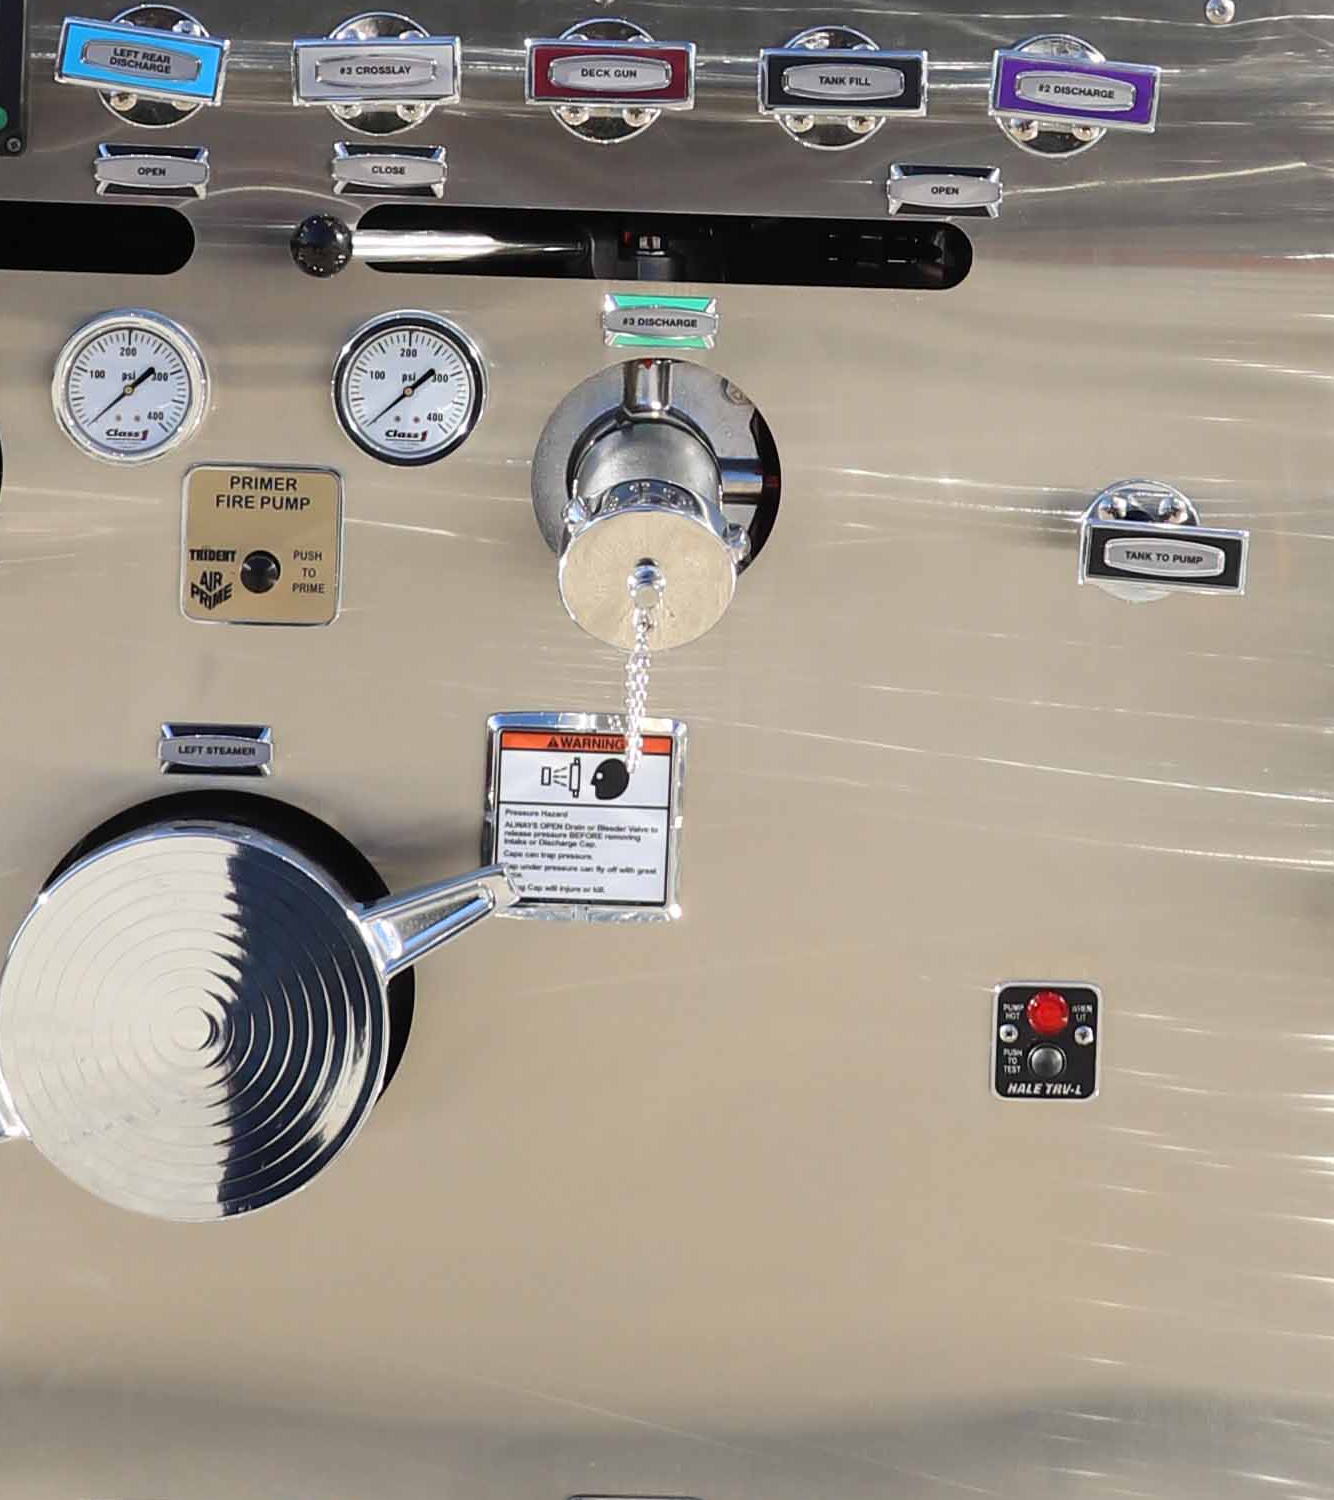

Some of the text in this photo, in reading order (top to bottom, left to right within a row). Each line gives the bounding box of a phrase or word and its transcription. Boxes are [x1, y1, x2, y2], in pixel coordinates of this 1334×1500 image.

[113, 48, 171, 64] LEFT REAR
[109, 57, 172, 75] DISCHARGE
[339, 66, 412, 76] #3 CROSSLAY
[581, 68, 637, 79] DECK GUN
[819, 76, 872, 86] TANK FILL
[1039, 83, 1115, 99] #2 DISCHARGE
[137, 166, 166, 177] OPEN
[371, 165, 406, 176] CLOSE
[931, 186, 959, 196] OPEN
[623, 318, 698, 329] #3 DISCHARGE
[119, 347, 137, 357] 200
[90, 370, 106, 379] 100
[105, 429, 149, 441] Class1
[385, 429, 428, 441] Class1
[230, 475, 298, 492] PRIMER
[215, 495, 311, 511] FIRE PUMP
[189, 548, 236, 563] TRIDENT
[293, 550, 323, 561] PUSH
[1125, 550, 1204, 565] TANK TO PUMP
[303, 568, 316, 578] TO
[199, 571, 224, 592] AIR
[292, 583, 325, 594] PRIME
[190, 582, 233, 611] PRIME
[561, 738, 625, 750] WARNING
[178, 746, 256, 756] LEFT STEAMER
[1002, 1003, 1024, 1011] PUMP
[1003, 1048, 1023, 1056] PUSH
[1008, 1057, 1017, 1065] TO
[1004, 1065, 1021, 1073] TEST
[1007, 1082, 1082, 1095] HALE TRV-L
